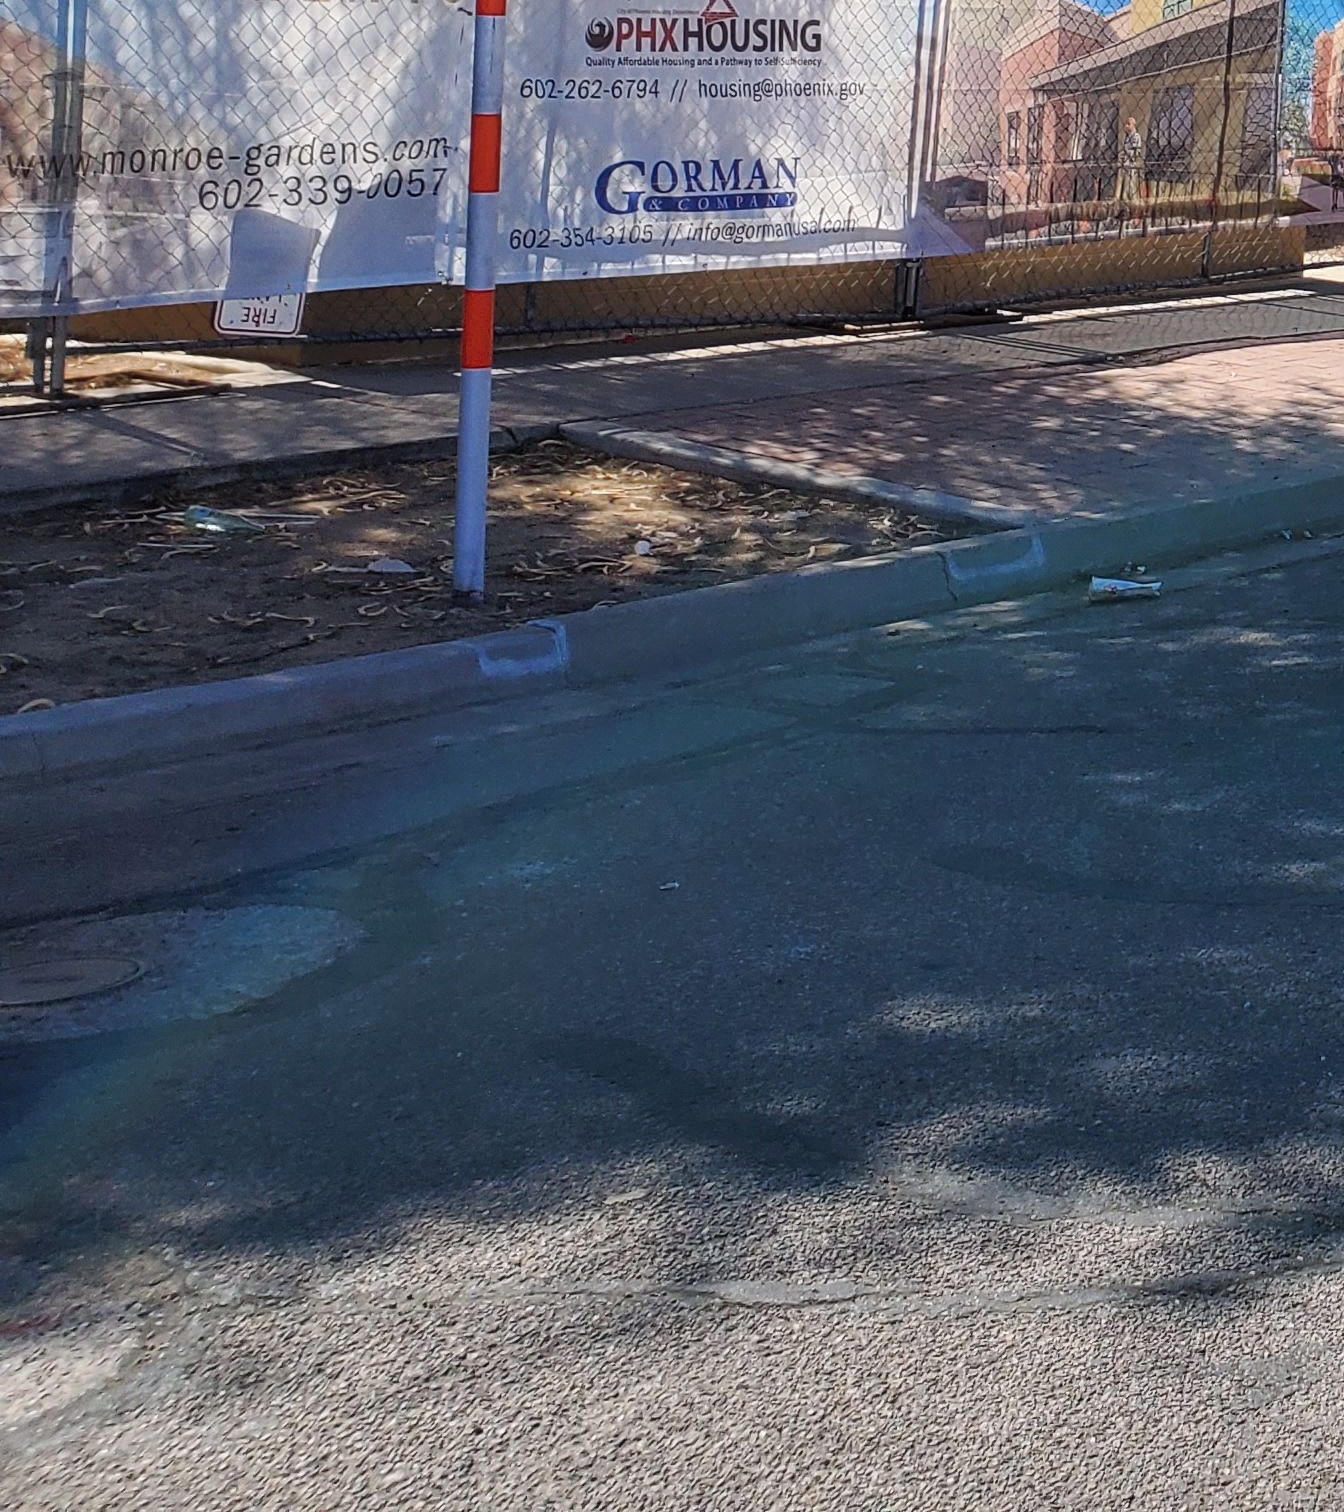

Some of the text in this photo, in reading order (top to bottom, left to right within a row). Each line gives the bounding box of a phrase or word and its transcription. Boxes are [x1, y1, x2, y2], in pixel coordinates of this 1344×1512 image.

[585, 57, 615, 68] Quality
[617, 57, 660, 67] Affordable
[661, 58, 695, 68] Housing
[697, 57, 713, 67] and
[721, 57, 752, 68] Pathway
[754, 58, 763, 67] to
[519, 78, 660, 99] 602-262-6794
[698, 78, 865, 102] housing@phoenix.gov
[6, 137, 447, 178] www.monroe-gardens.com
[199, 168, 447, 210] 602-339-0057
[595, 157, 800, 215] GORMAN
[677, 193, 796, 210] COMPANY
[509, 224, 653, 250] 602-354-3105
[686, 219, 856, 244] info@gormanusa.com
[241, 306, 277, 325] FIRE
